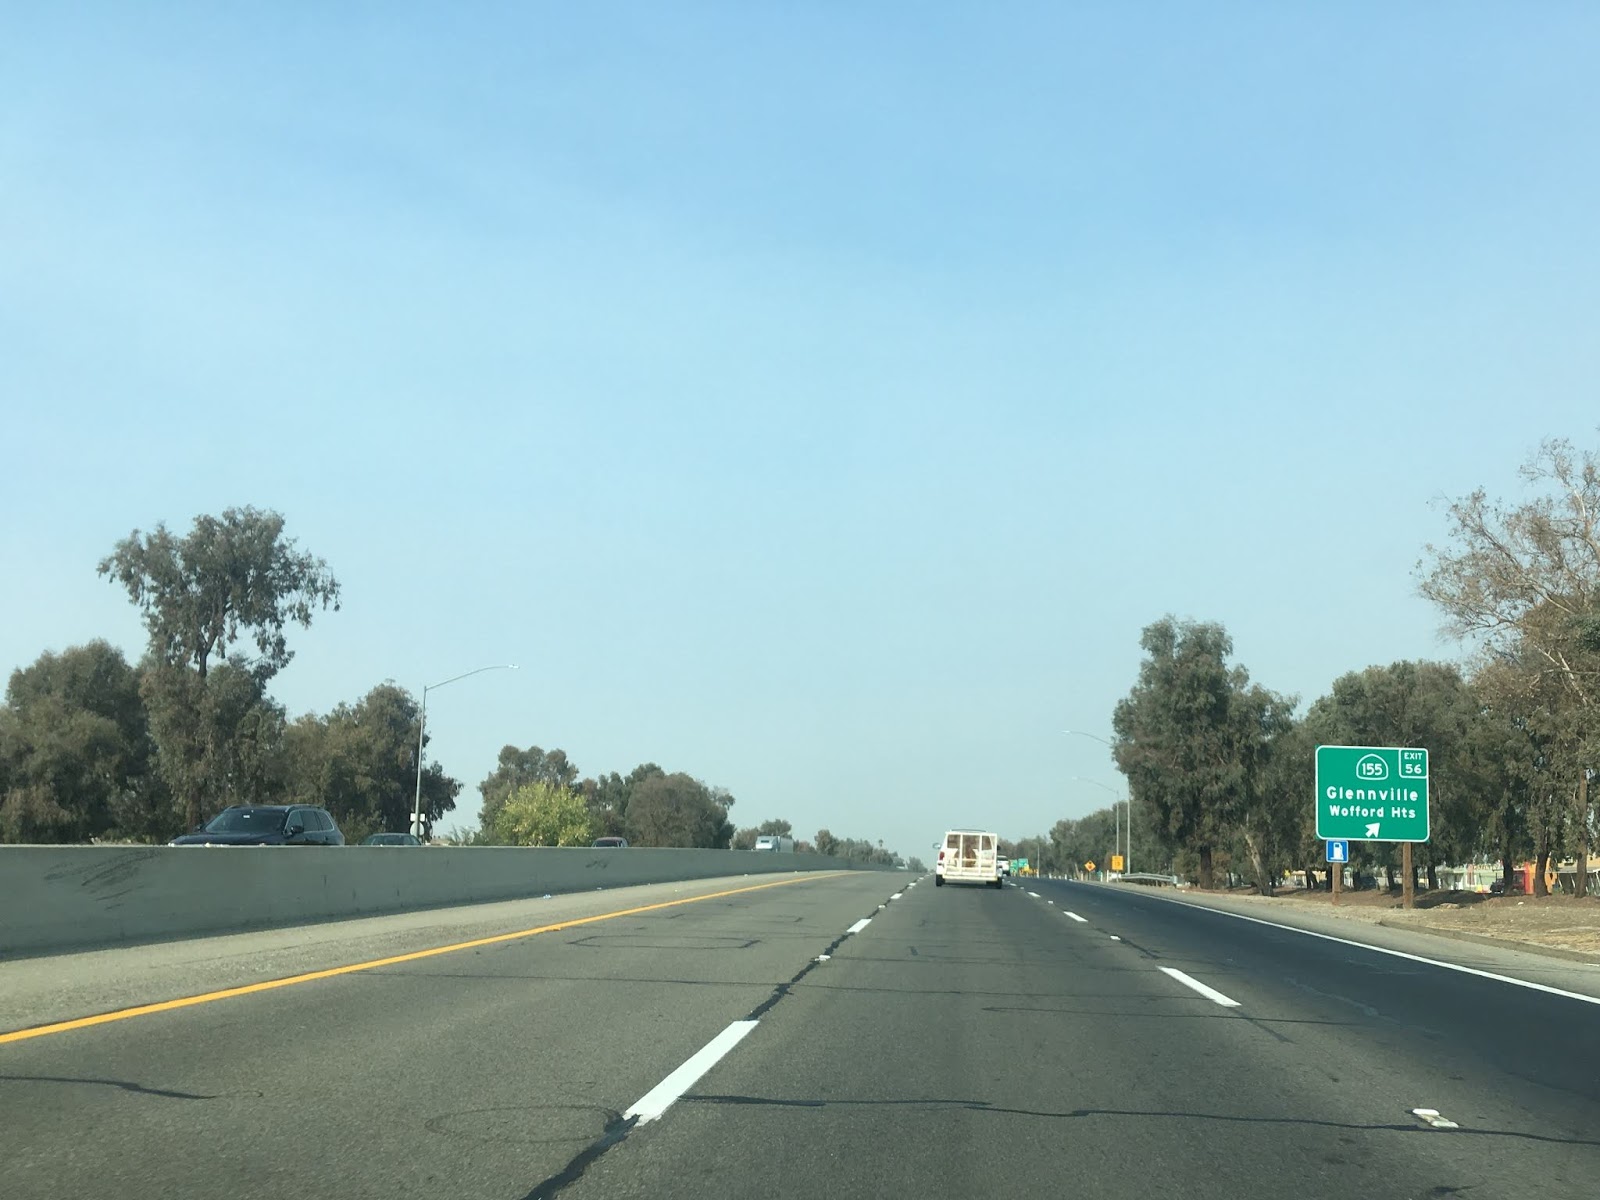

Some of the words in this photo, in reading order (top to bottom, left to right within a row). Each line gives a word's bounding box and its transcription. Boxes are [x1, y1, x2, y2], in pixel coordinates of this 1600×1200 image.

[1404, 752, 1423, 760] EXIT
[1362, 763, 1383, 776] 155
[1405, 764, 1422, 774] 56
[1326, 786, 1418, 801] Glennville
[1329, 805, 1384, 818] Wofford
[1391, 807, 1416, 818] Hts
